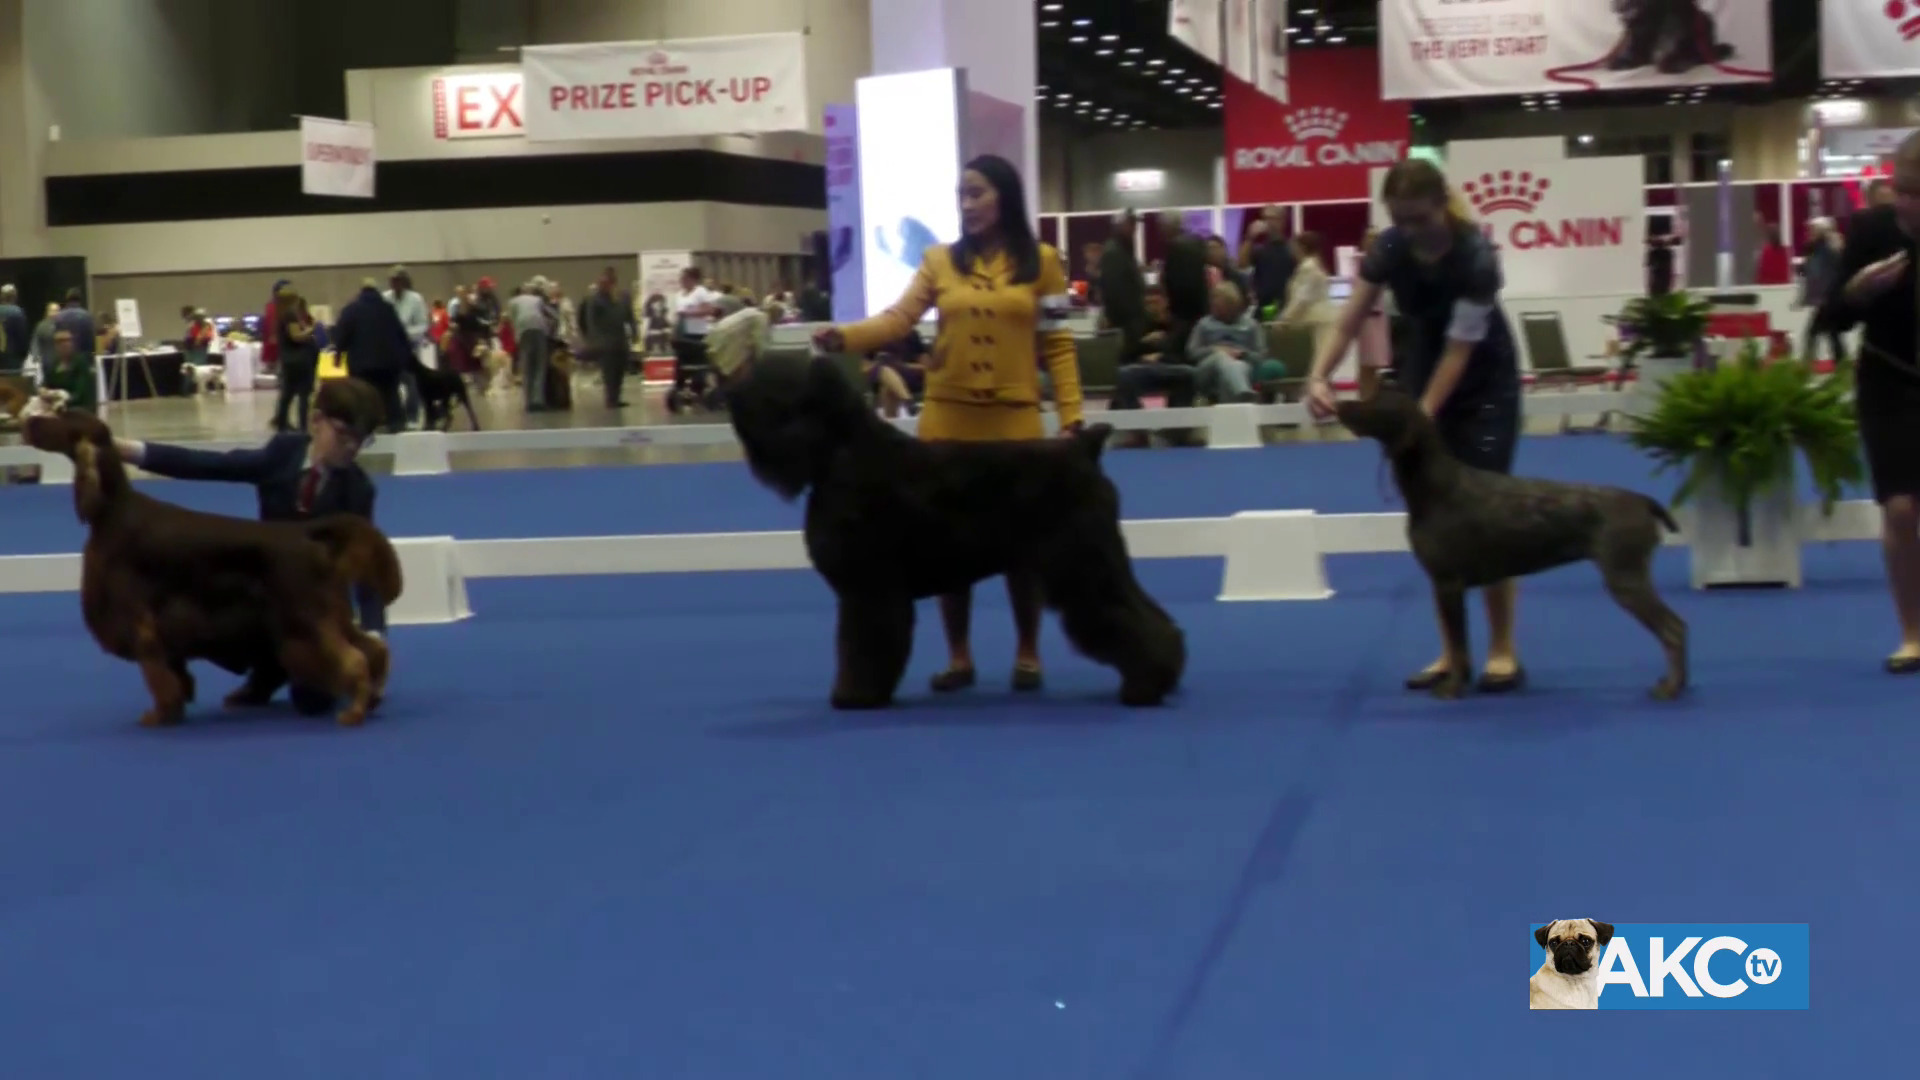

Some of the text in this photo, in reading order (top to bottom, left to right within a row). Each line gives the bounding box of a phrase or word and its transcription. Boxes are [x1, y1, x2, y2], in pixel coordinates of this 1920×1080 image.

[1409, 40, 1443, 60] THE
[456, 83, 523, 130] EX
[550, 76, 772, 111] PRIZE PICK-UP
[1234, 146, 1315, 170] ROYAL
[1509, 217, 1623, 250] CANIN
